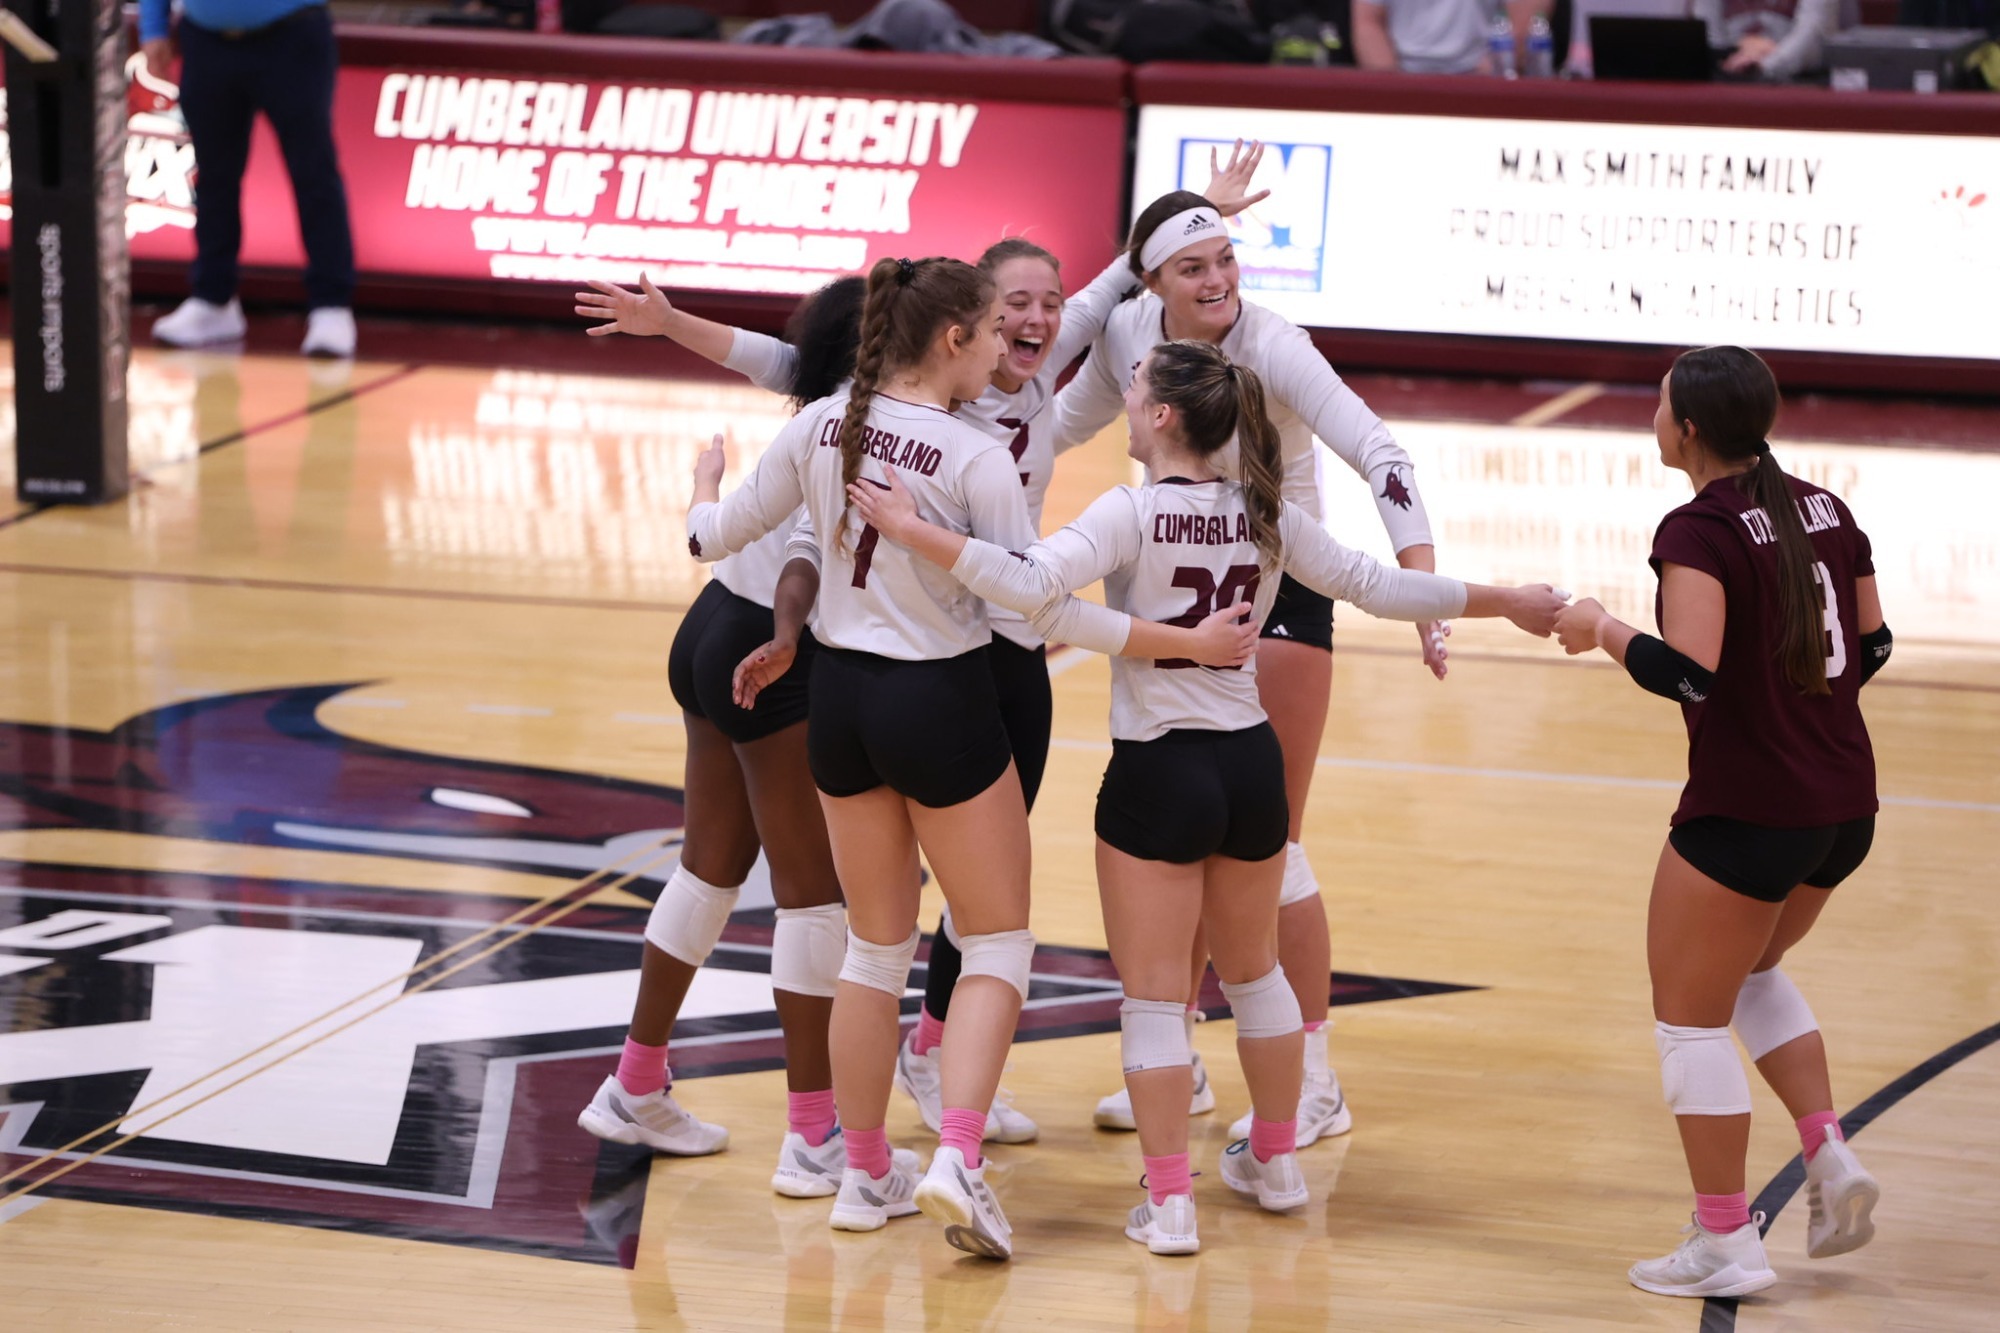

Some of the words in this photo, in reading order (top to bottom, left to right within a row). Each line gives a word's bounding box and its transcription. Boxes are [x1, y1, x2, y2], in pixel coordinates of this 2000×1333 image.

[375, 74, 692, 153] CUMBERLAND
[691, 91, 978, 167] UNIVERSITY
[405, 145, 544, 213] HOME
[544, 152, 612, 217] OF
[616, 156, 707, 223] THE
[704, 161, 918, 234] PHOENIX
[1497, 145, 1569, 184] MAX
[1582, 148, 1687, 190] SMITH
[1700, 152, 1822, 196] FAMILY
[1183, 222, 1215, 236] adidas
[1449, 207, 1566, 248] PROUD
[1580, 212, 1809, 259] SUPPORTERS
[1822, 222, 1864, 262] OF
[819, 418, 943, 477] CUBERLAND
